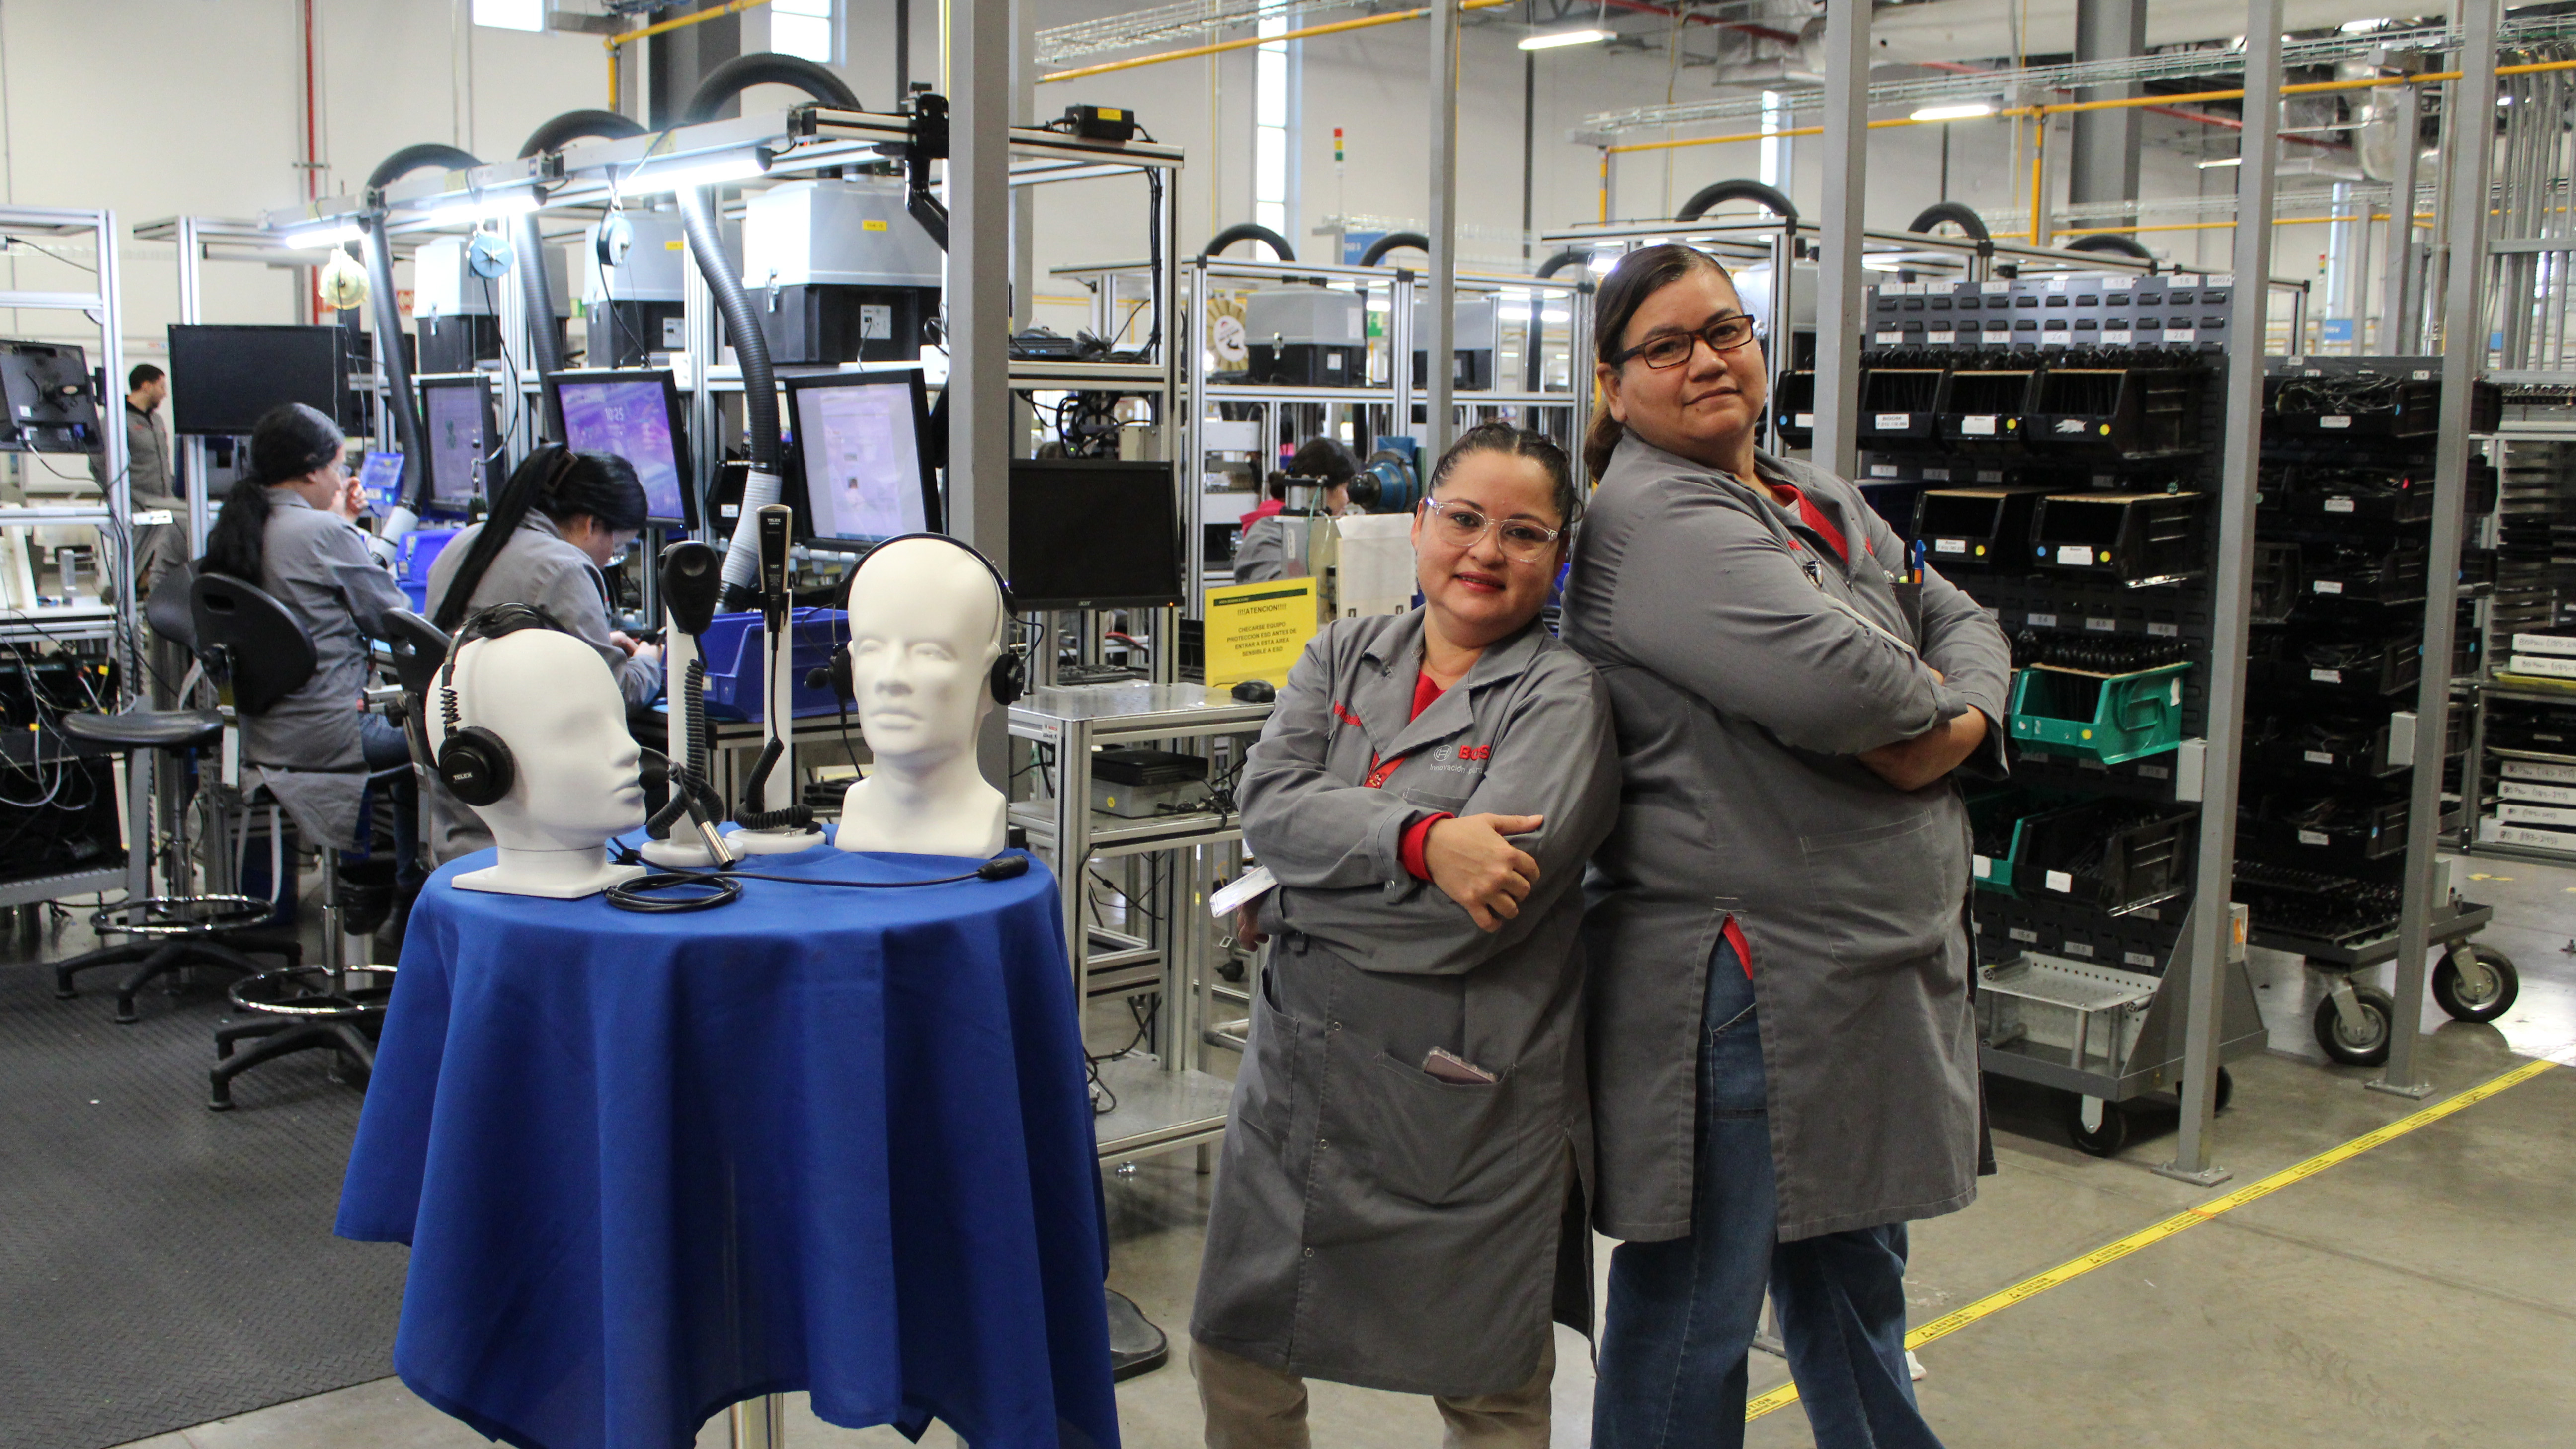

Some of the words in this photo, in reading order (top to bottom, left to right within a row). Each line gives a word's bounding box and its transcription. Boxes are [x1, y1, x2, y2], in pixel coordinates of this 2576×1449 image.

[605, 406, 624, 421] 10:25
[1238, 624, 1265, 633] CHECARSE
[1227, 634, 1260, 642] PROTECCION
[1243, 648, 1266, 656] SENSIBLE
[1458, 745, 1490, 761] BOS
[1429, 764, 1465, 774] Innovación
[453, 772, 473, 781] TELEX
[1931, 1313, 1964, 1329] CAUTION
